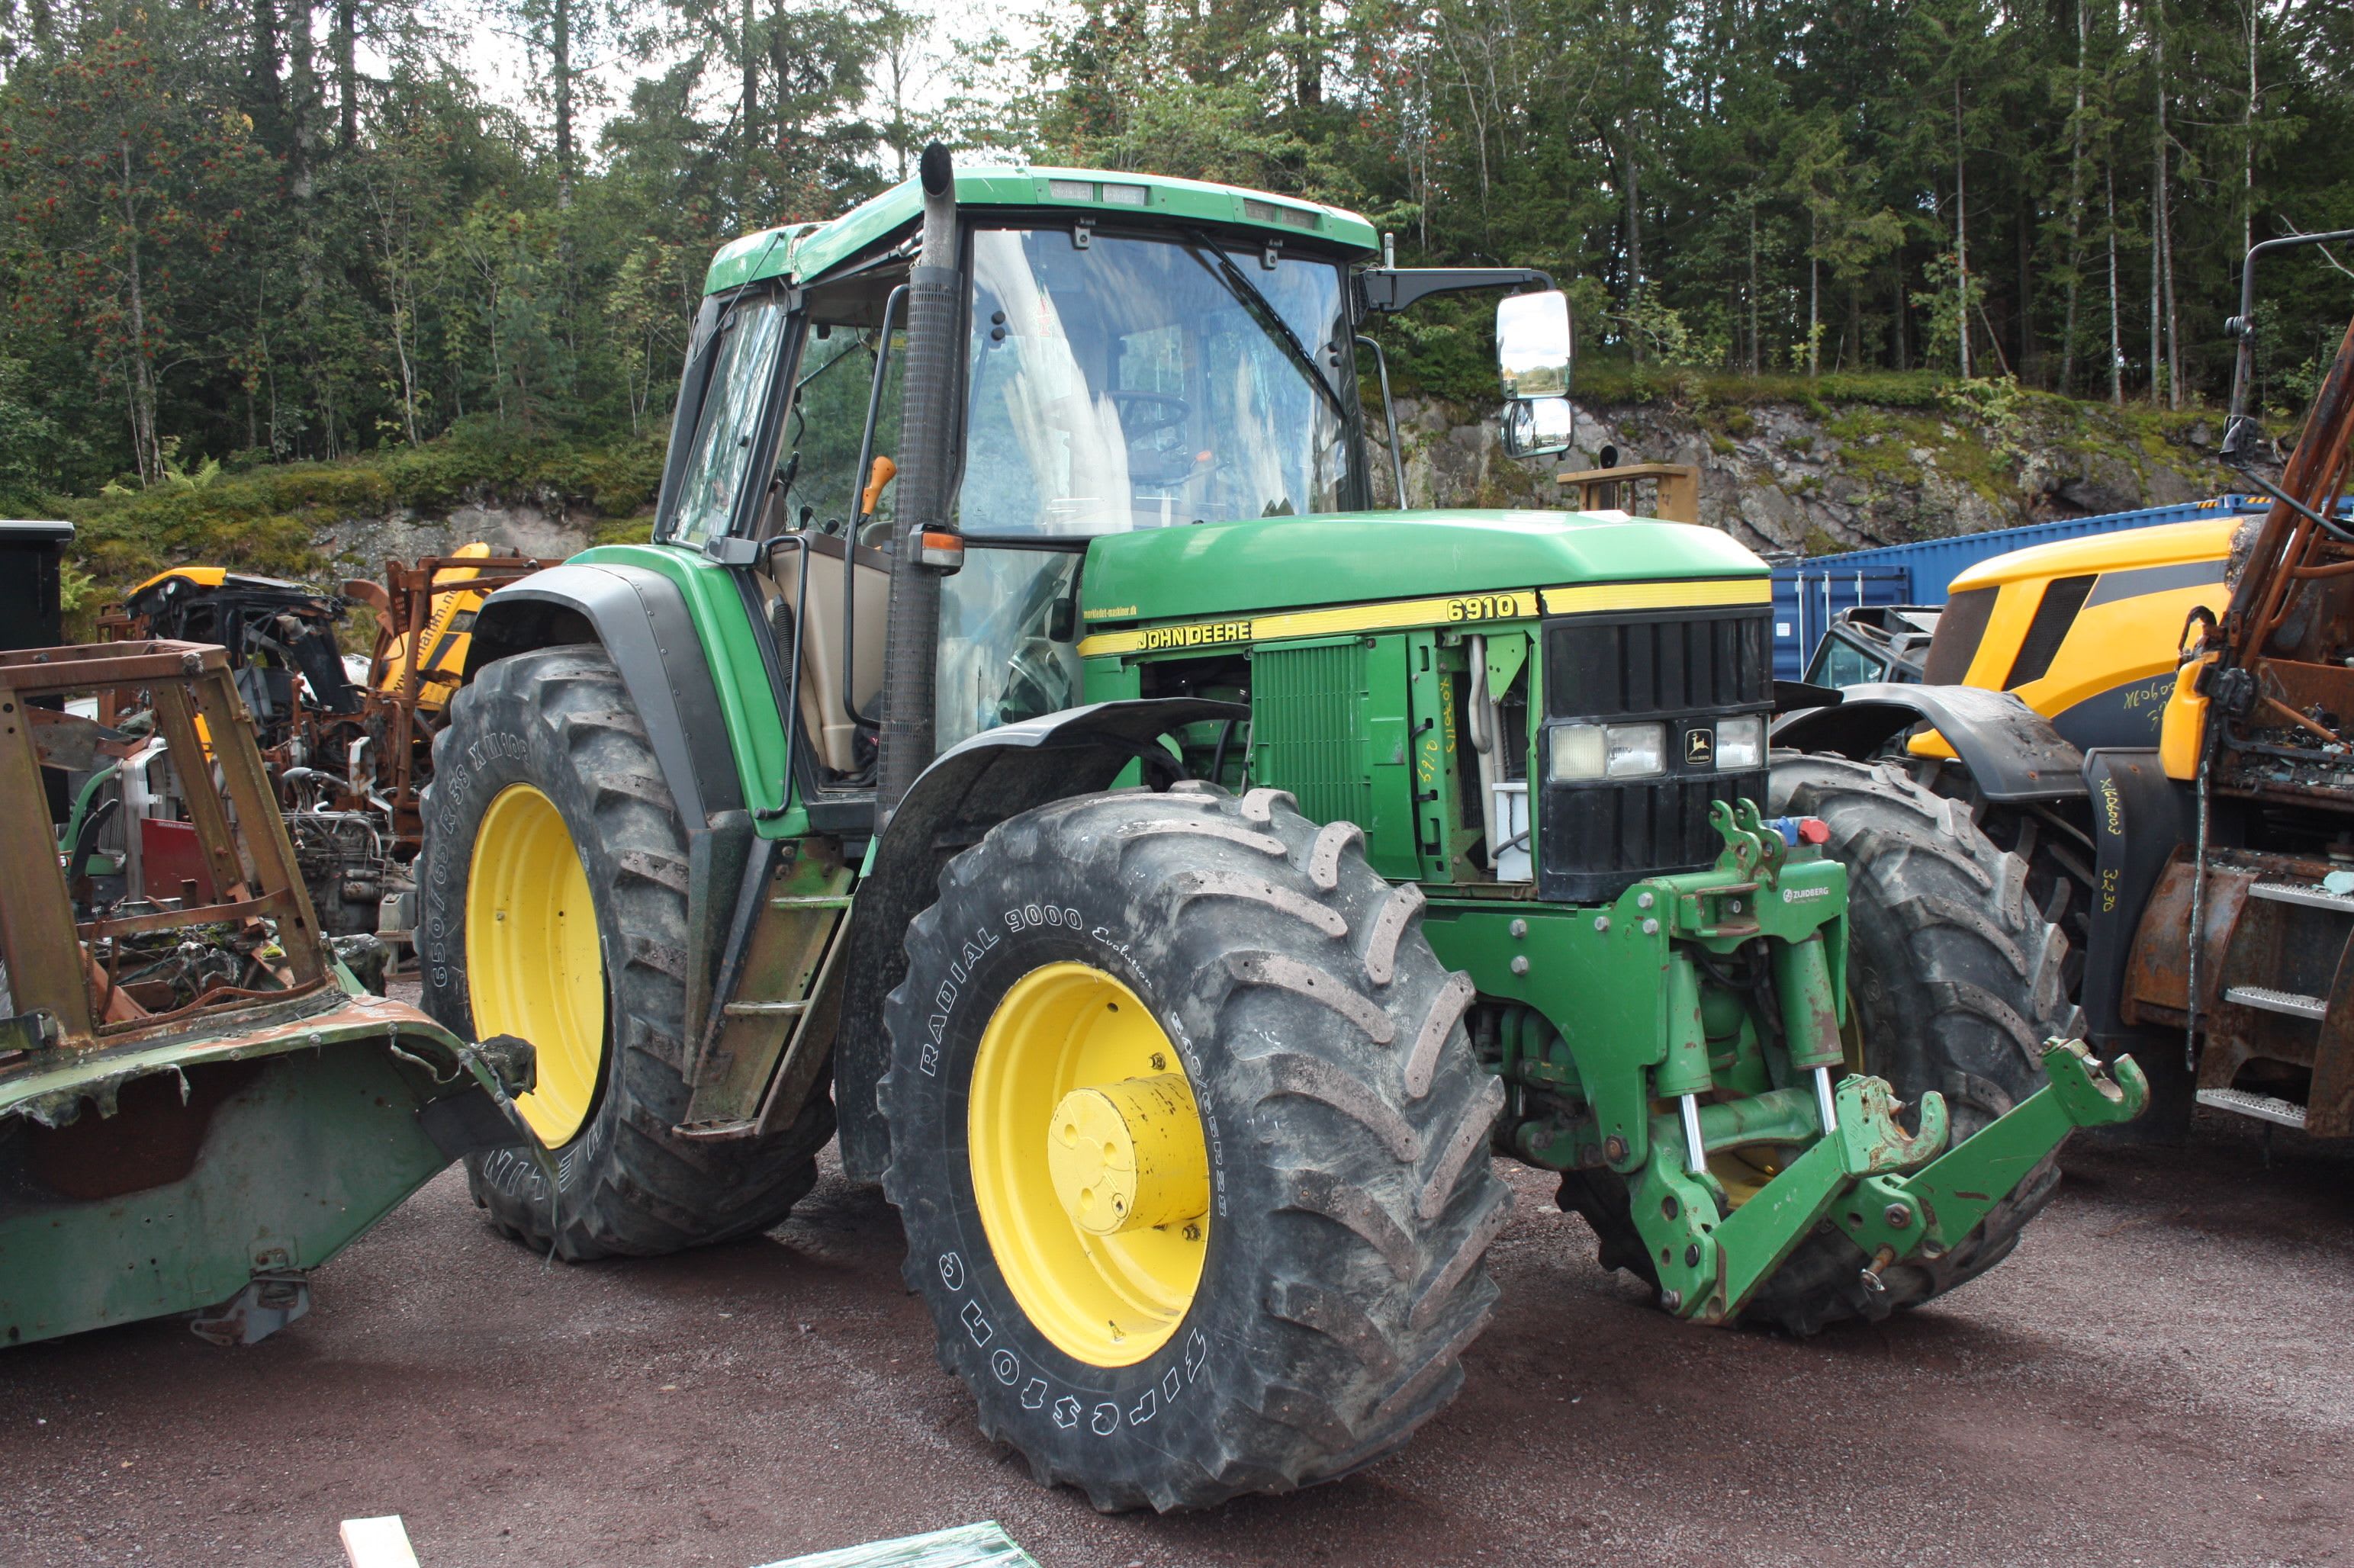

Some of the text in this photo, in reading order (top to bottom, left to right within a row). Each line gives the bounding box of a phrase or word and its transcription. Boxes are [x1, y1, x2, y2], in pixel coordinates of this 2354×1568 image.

[1447, 595, 1516, 622] 6910
[1137, 622, 1251, 649] JOHN DEERE
[439, 805, 456, 835] R
[449, 763, 471, 805] 38
[1793, 887, 1829, 899] ZUIDBERG
[919, 904, 1153, 1078] RADIAL 9000 Evolution
